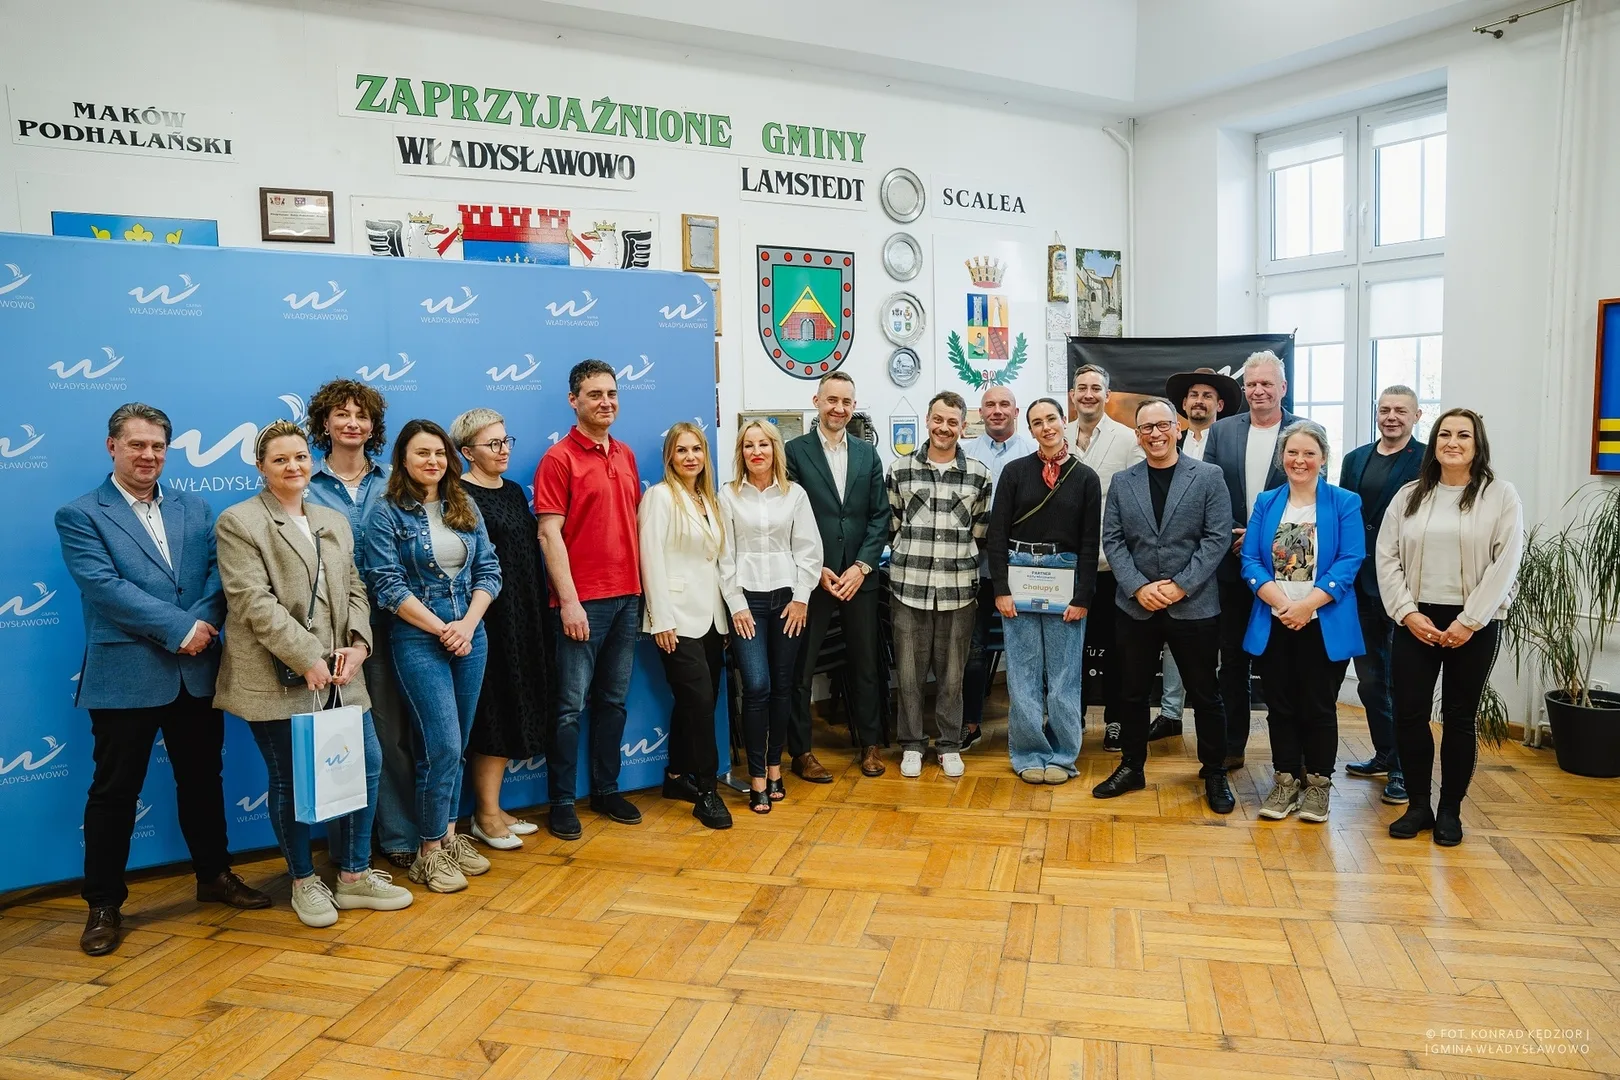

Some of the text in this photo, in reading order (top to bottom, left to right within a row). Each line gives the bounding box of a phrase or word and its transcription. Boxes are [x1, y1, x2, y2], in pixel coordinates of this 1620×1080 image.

[72, 101, 187, 128] MAKÓW
[355, 74, 866, 163] ZAPRZYJAŹNIONE GMINY
[396, 136, 636, 180] WŁADYSŁAWOWO
[741, 167, 865, 202] LAMSTEDT
[943, 187, 1026, 214] SCALEA
[129, 307, 203, 317] WŁADYSŁAWOWO
[283, 313, 348, 321] WŁADYSŁAWOWO
[420, 316, 480, 325] WŁADYSŁAWOWO
[545, 319, 599, 327] WŁADYSŁAWOWO
[49, 382, 127, 391] WŁADYSŁAWOWO
